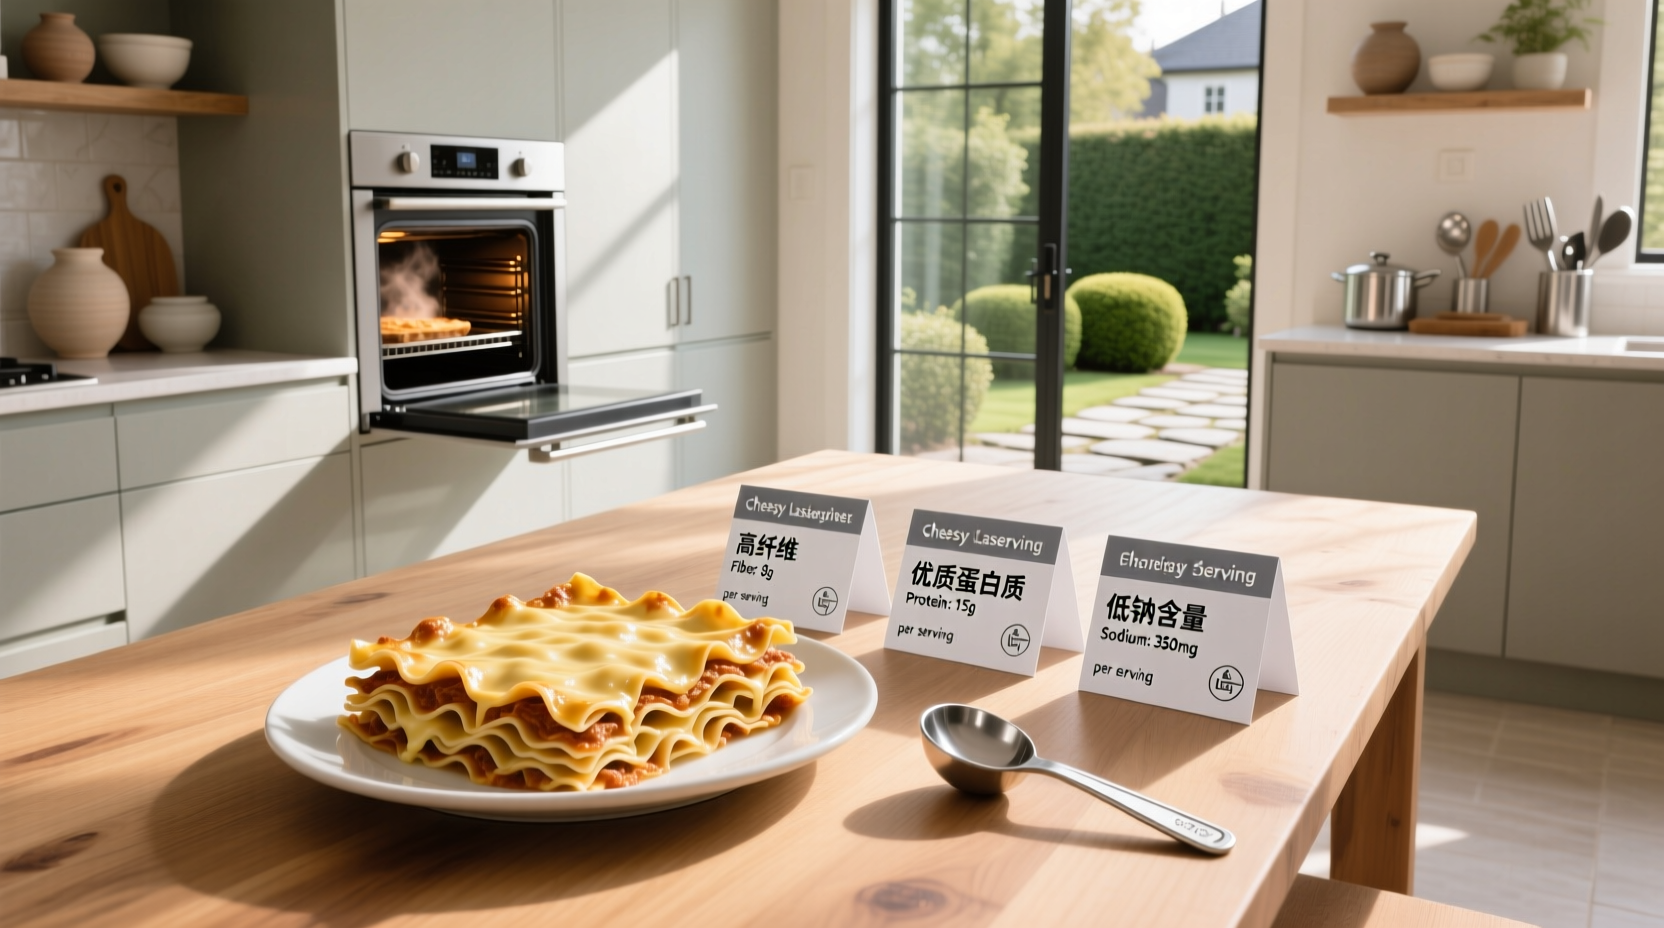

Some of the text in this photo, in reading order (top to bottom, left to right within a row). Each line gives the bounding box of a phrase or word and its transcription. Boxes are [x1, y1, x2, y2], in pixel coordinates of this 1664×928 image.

[736, 532, 799, 561] 高纤维
[922, 521, 970, 546] Cheesy
[911, 560, 1026, 601] 优质蛋白质
[905, 591, 976, 617] Protein: 15g
[1106, 592, 1208, 633] 低钠含量
[897, 624, 914, 637] per
[1100, 626, 1199, 659] Sodium: 350mg
[1092, 662, 1113, 677] per
